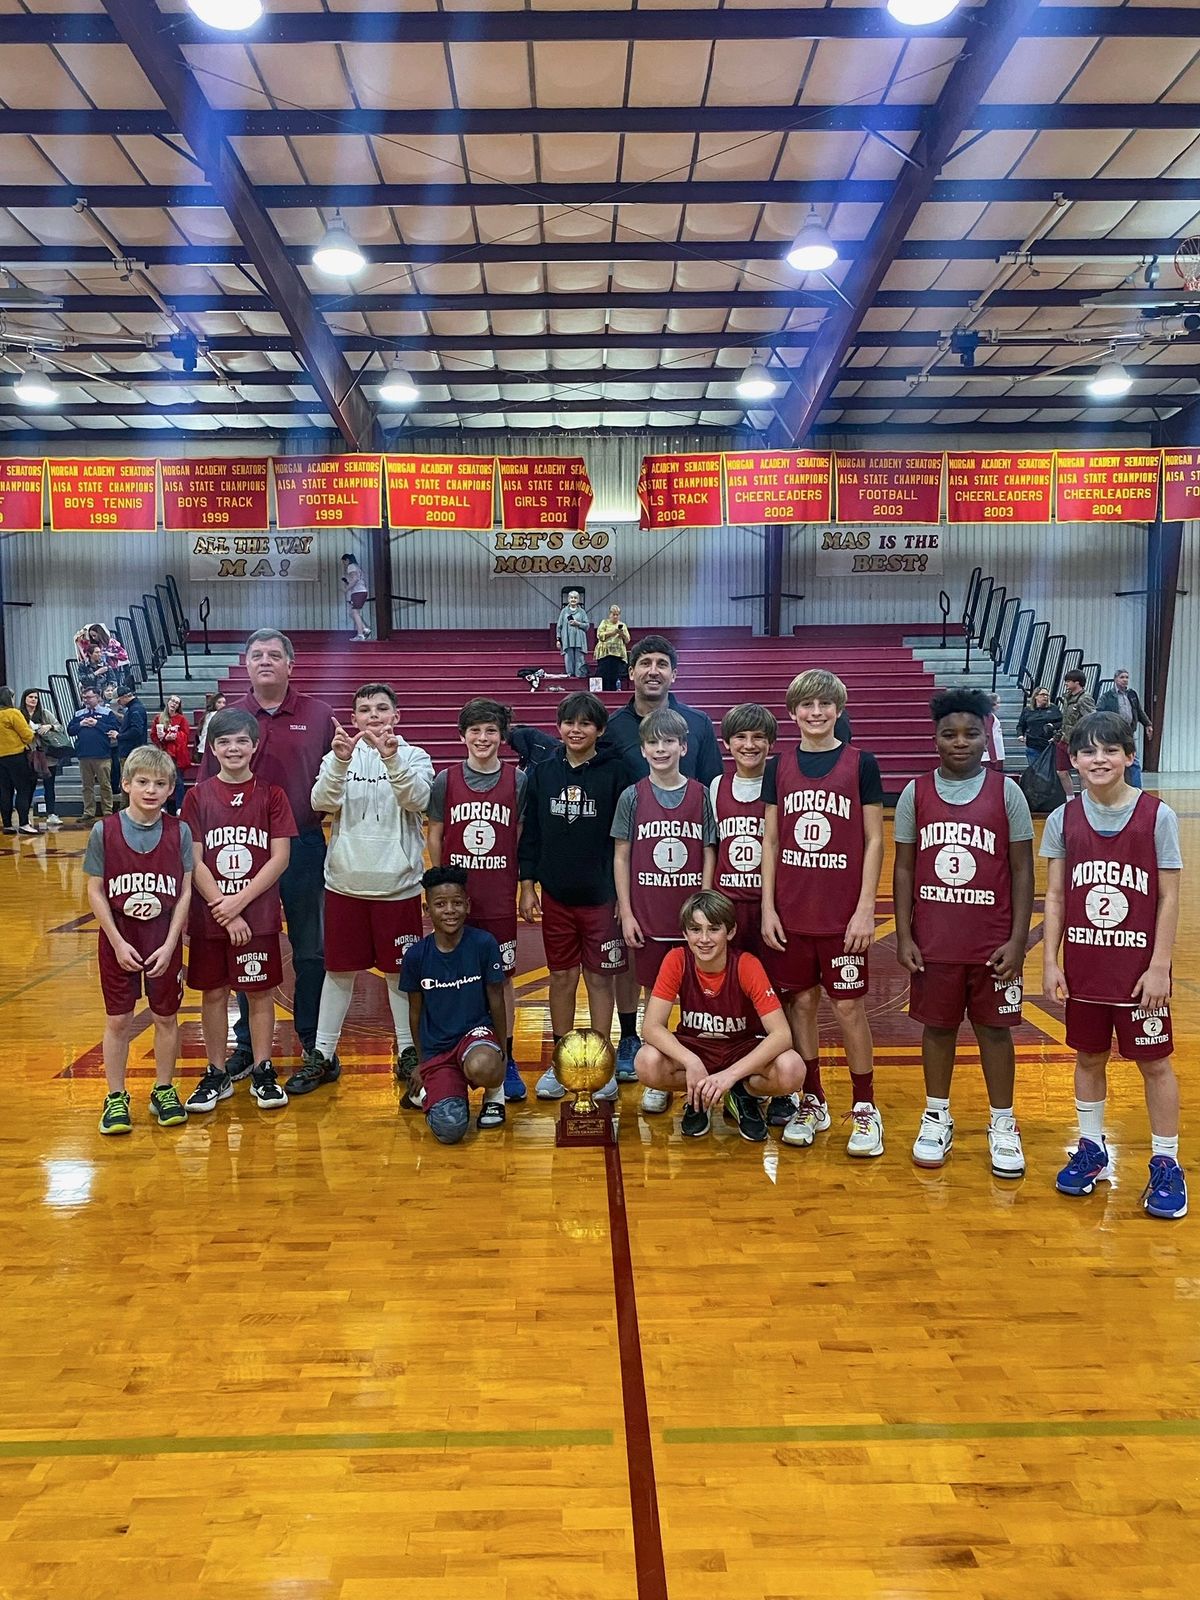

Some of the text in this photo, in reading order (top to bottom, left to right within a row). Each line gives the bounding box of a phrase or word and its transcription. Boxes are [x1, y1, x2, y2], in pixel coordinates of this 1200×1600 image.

[727, 457, 830, 471] MORGAN ACADEMY SENATORS
[837, 458, 942, 470] MORGAN ACADEMY SENATORS
[949, 458, 1050, 469] MORGAN ACADEMY SENATORS
[1058, 456, 1159, 468] MORGAN ACADEMY SENATORS
[1165, 455, 1193, 465] MORGAN
[7, 466, 41, 476] SENATORS
[50, 465, 154, 476] MORGAN ACADEMY SENATORS
[162, 465, 266, 476] MORGAN ACADEMY SENATORS
[275, 461, 380, 474] MORGAN ACADEMY SENATORS
[387, 462, 492, 475] MORGAN ACADEMY SENATORS
[501, 464, 528, 475] MORGAN
[534, 464, 566, 475] ACADEMY
[651, 461, 680, 474] ACADEMY
[684, 460, 720, 472] SENATORS
[728, 473, 829, 487] AISA STATE CHAMPIONS
[839, 474, 939, 486] AISA STATE CHAMPIONS
[950, 475, 1050, 486] AISA STATE CHAMPIONS
[1058, 472, 1157, 484] AISA STATE CHAMPIONS
[1166, 471, 1185, 482] AISA
[0, 481, 40, 492] HAMPIONS
[53, 481, 154, 493] AISA STATE CHAMPIONS
[165, 481, 266, 492] AISA STATE CHAMPIONS
[277, 478, 379, 490] AISA STATE CHAMPIONS
[390, 479, 492, 491] AISA STATE CHAMPIONS
[503, 480, 522, 491] AISA
[528, 480, 553, 491] STATE
[673, 477, 719, 489] CHAMPIONS
[299, 494, 359, 505] FOOTBALL
[673, 493, 709, 505] TRACK
[735, 490, 822, 503] CHEERLEADERS
[859, 489, 918, 501] FOOTBALL
[955, 490, 1043, 501] CHEERLEADERS
[1064, 488, 1152, 500] CHEERLEADERS
[64, 498, 143, 509] BOYS TENNIS
[178, 497, 253, 508] BOYS TRACK
[410, 495, 471, 507] FOOTBALL
[514, 497, 547, 507] GIRLS
[315, 509, 343, 520] 1999
[657, 510, 686, 522] 2002
[764, 506, 794, 518] 2002
[873, 505, 903, 516] 2003
[984, 507, 1014, 517] 2003
[1092, 505, 1122, 515] 2004
[90, 513, 117, 524] 1999
[202, 513, 229, 523] 1999
[426, 511, 456, 522] 2000
[540, 512, 568, 522] 2001
[193, 536, 313, 554] ALL THE WAY
[495, 531, 610, 550] LET'S GO
[821, 532, 939, 550] MAS IS THE
[494, 555, 612, 573] MORGAN!
[852, 554, 928, 572] BEST!
[784, 790, 851, 820] MORGAN
[450, 801, 510, 826] MORGAN
[637, 820, 703, 841] MORGAN
[719, 816, 765, 841] MORGA
[804, 824, 820, 841] 10
[205, 826, 269, 850] MORGAN
[475, 831, 484, 845] 5
[920, 822, 996, 855] MORGAN
[667, 847, 673, 862] 1
[735, 846, 752, 862] 20
[782, 849, 848, 870] SENATORS
[228, 854, 240, 870] 11
[450, 854, 507, 870] SENATORS
[949, 856, 960, 874] 3
[638, 873, 702, 887] SENATORS
[720, 873, 761, 888] SENATO
[1071, 860, 1149, 896] MORGAN
[108, 872, 177, 898] MORGAN
[920, 886, 995, 905] SENATORS
[132, 903, 151, 917] 22
[1099, 897, 1110, 916] 2
[1068, 927, 1147, 948] SENATORS
[236, 952, 268, 964] MORGAN
[831, 955, 865, 968] MORGAN
[237, 973, 267, 982] SENATORS
[846, 969, 855, 977] 10
[421, 974, 482, 990] Champion
[833, 979, 864, 990] SENATORS
[1011, 991, 1016, 999] 3
[1131, 1006, 1168, 1022] MORGAN
[682, 1010, 747, 1034] MORGAN
[1150, 1022, 1156, 1031] 2
[1135, 1033, 1169, 1045] SENATORS
